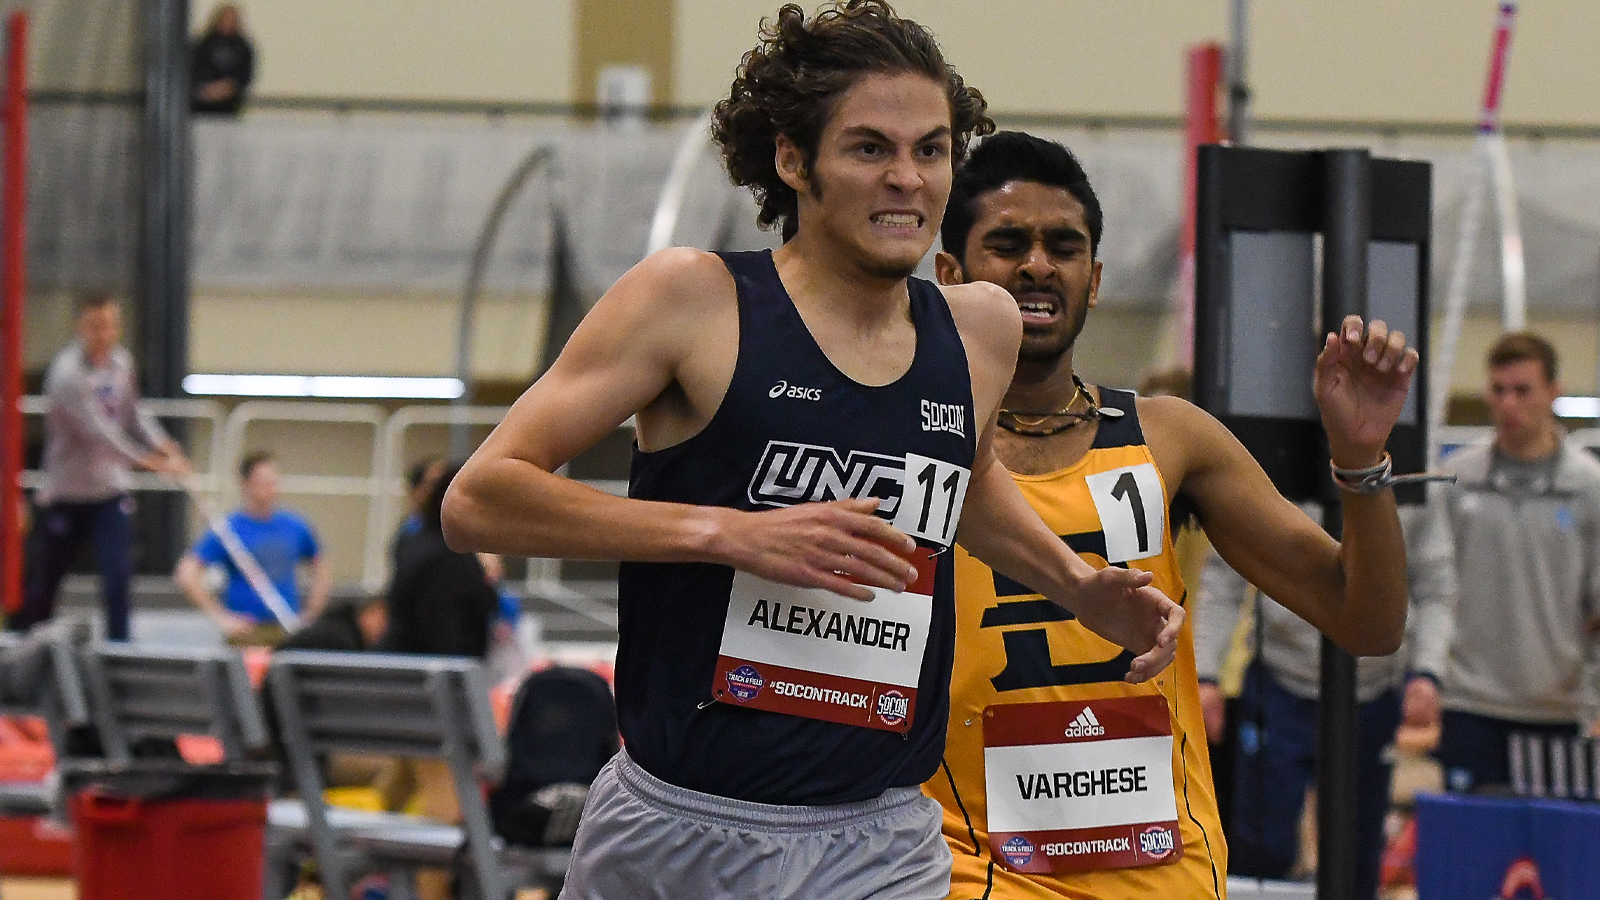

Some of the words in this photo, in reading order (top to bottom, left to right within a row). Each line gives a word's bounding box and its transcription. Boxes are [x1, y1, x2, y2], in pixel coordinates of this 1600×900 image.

[786, 386, 822, 401] asics
[921, 399, 965, 438] SOCON
[917, 462, 961, 539] 11
[1111, 471, 1148, 553] 1
[747, 599, 911, 652] ALEXANDER
[770, 680, 869, 709] #SOCONTRACK
[876, 693, 910, 719] SOCON
[1065, 725, 1105, 737] adidas
[1016, 766, 1148, 800] VARGHESE
[1040, 837, 1131, 857] #SOCONTRACK
[1139, 829, 1174, 852] SOCON
